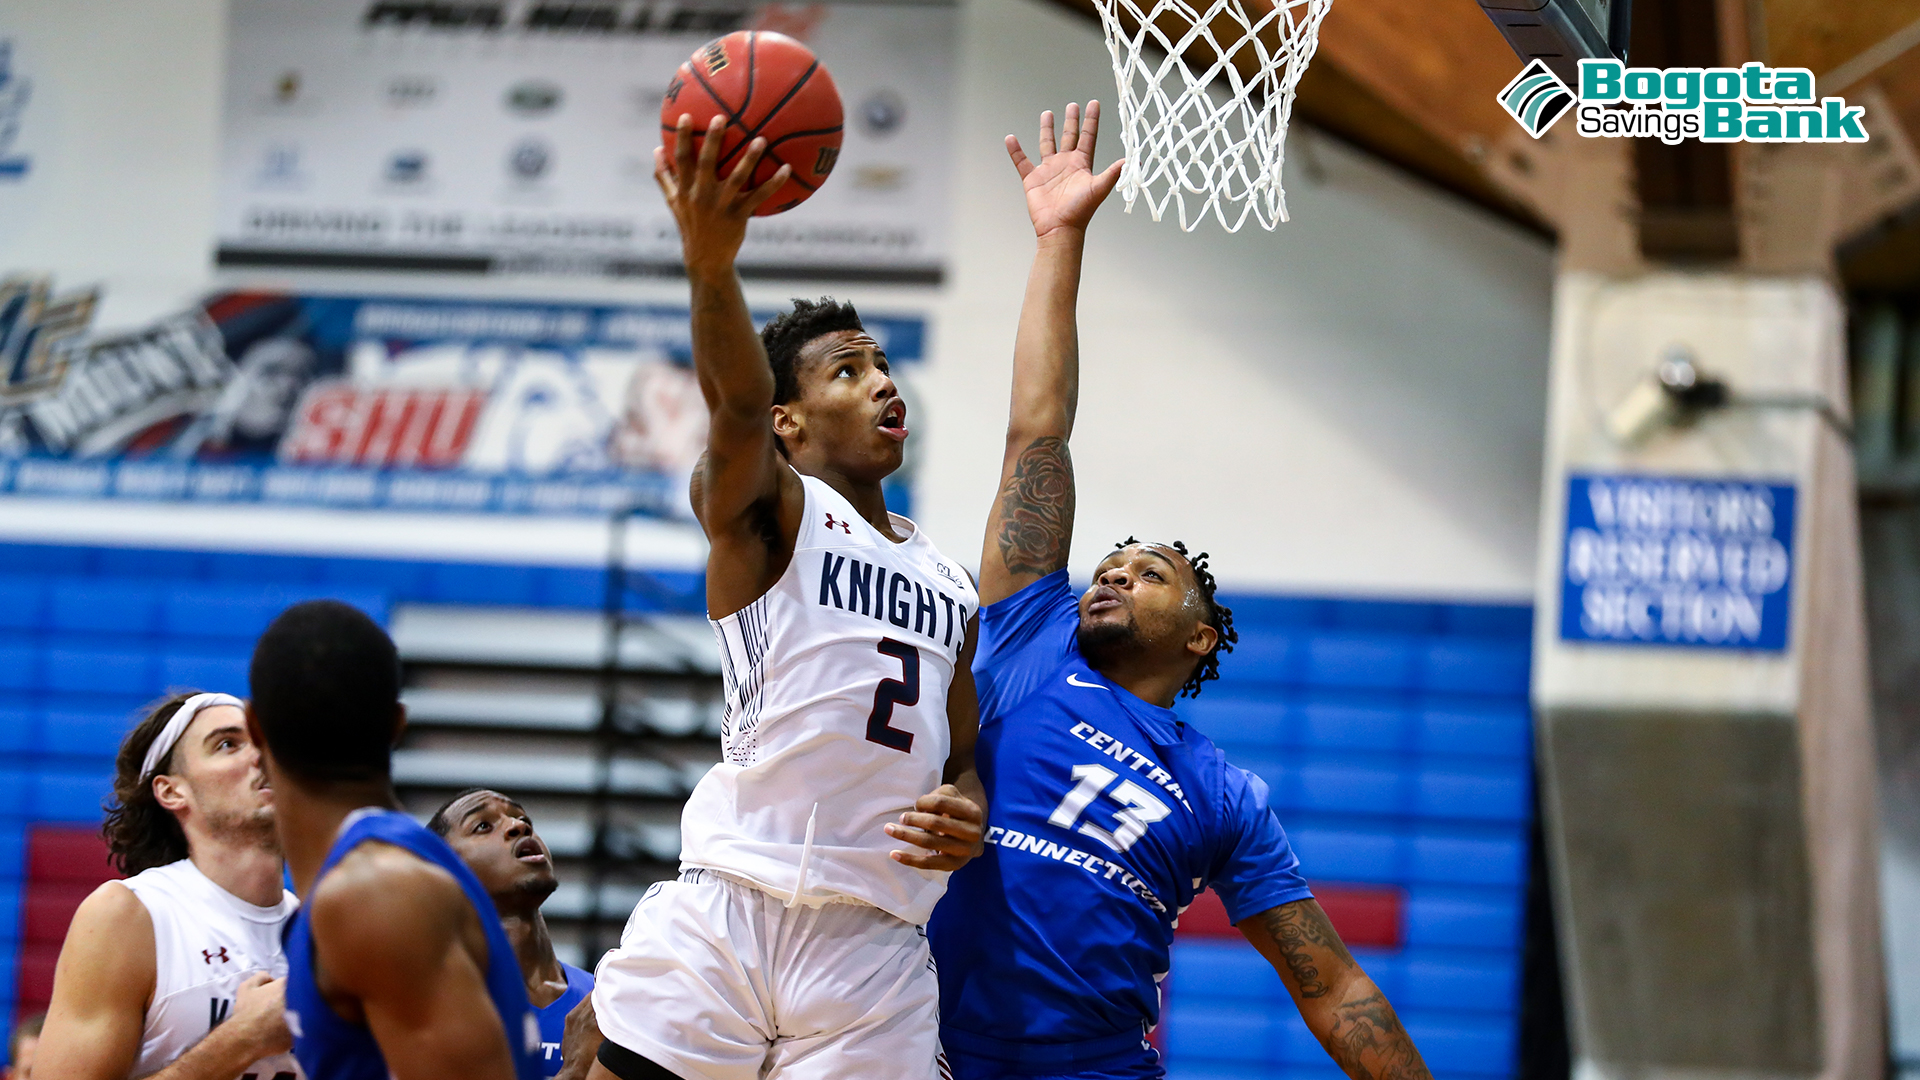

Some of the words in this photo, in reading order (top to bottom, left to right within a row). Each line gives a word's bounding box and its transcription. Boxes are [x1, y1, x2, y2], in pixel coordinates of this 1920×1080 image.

[290, 384, 492, 471] SHU
[1588, 480, 1774, 534] VISITORS
[819, 551, 968, 657] KNIGHTS
[1569, 528, 1788, 593] RESERVED
[1580, 582, 1764, 641] SECTION
[865, 636, 920, 754] 2
[1047, 763, 1173, 854] 13
